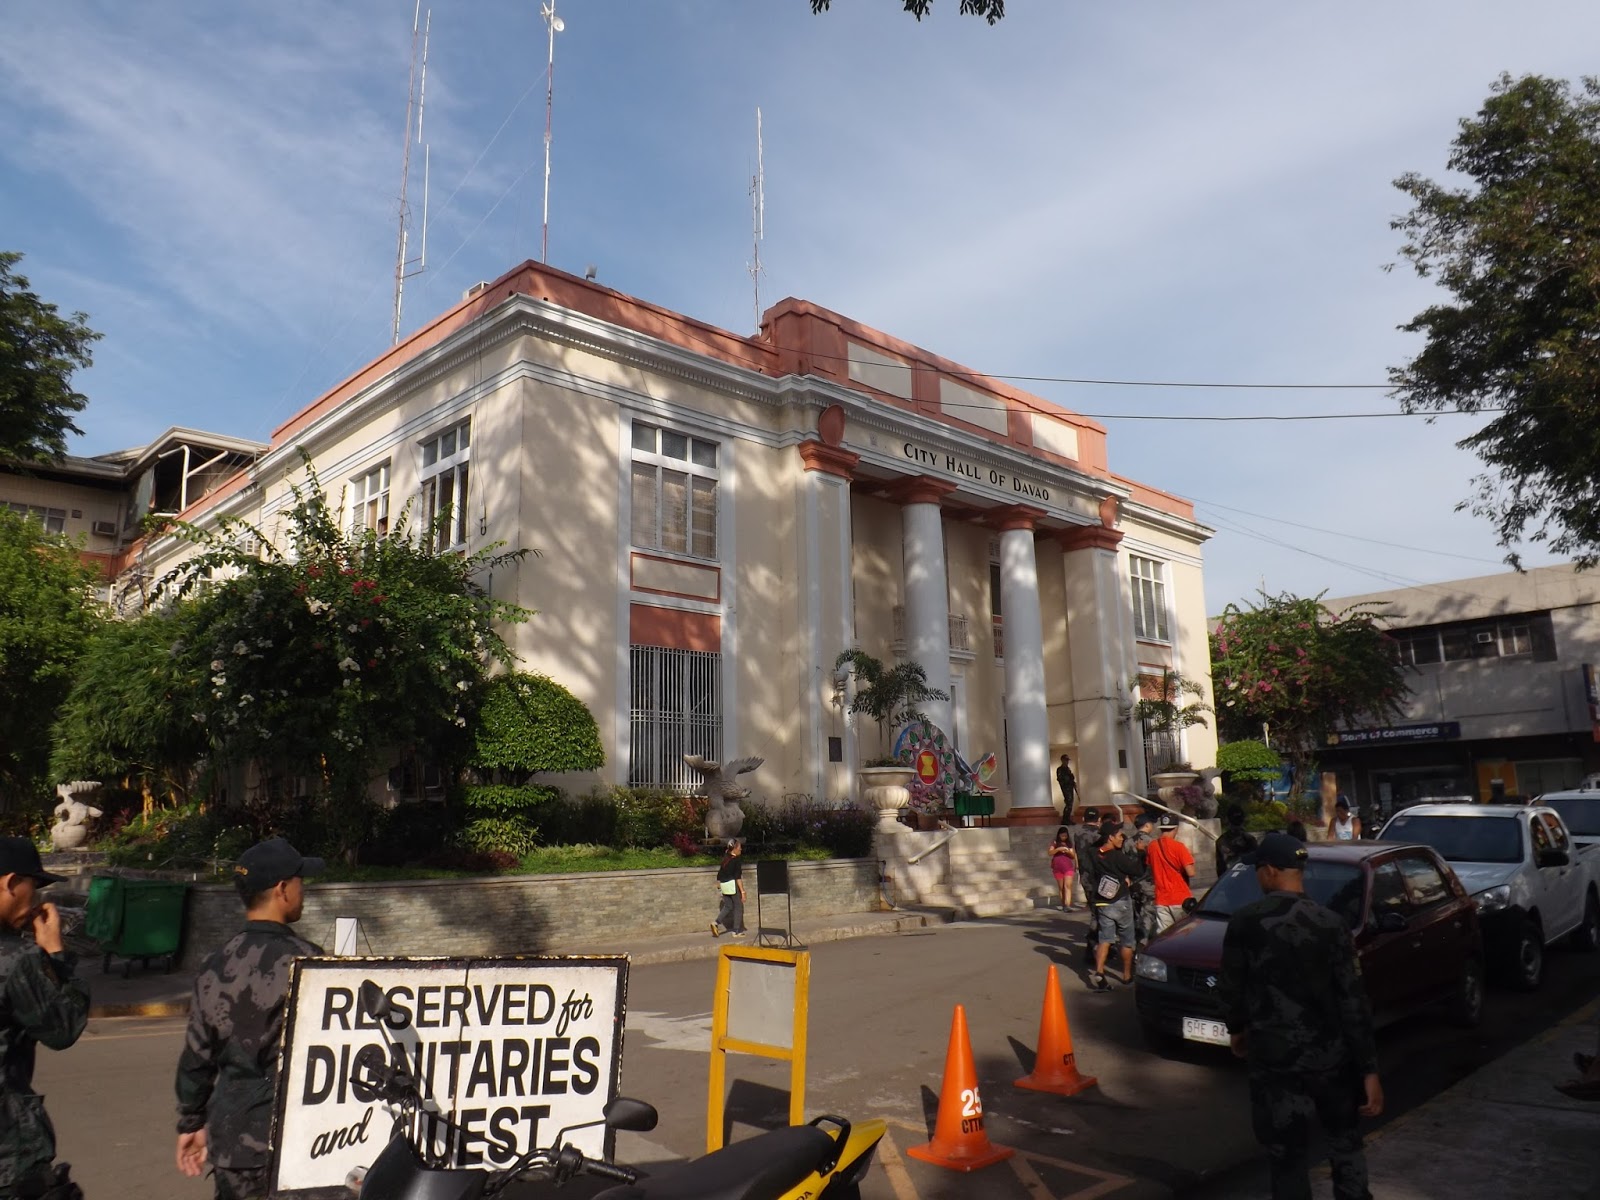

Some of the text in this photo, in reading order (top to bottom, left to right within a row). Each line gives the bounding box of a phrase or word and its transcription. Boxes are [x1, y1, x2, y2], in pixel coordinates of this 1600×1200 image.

[904, 443, 1049, 501] CITY HALL OF DAVAO
[321, 983, 594, 1038] RESERVED for
[1187, 1020, 1207, 1036] SHE
[301, 1036, 600, 1106] DIGNITARIES
[961, 1087, 983, 1117] 25
[310, 1104, 551, 1169] and UEST
